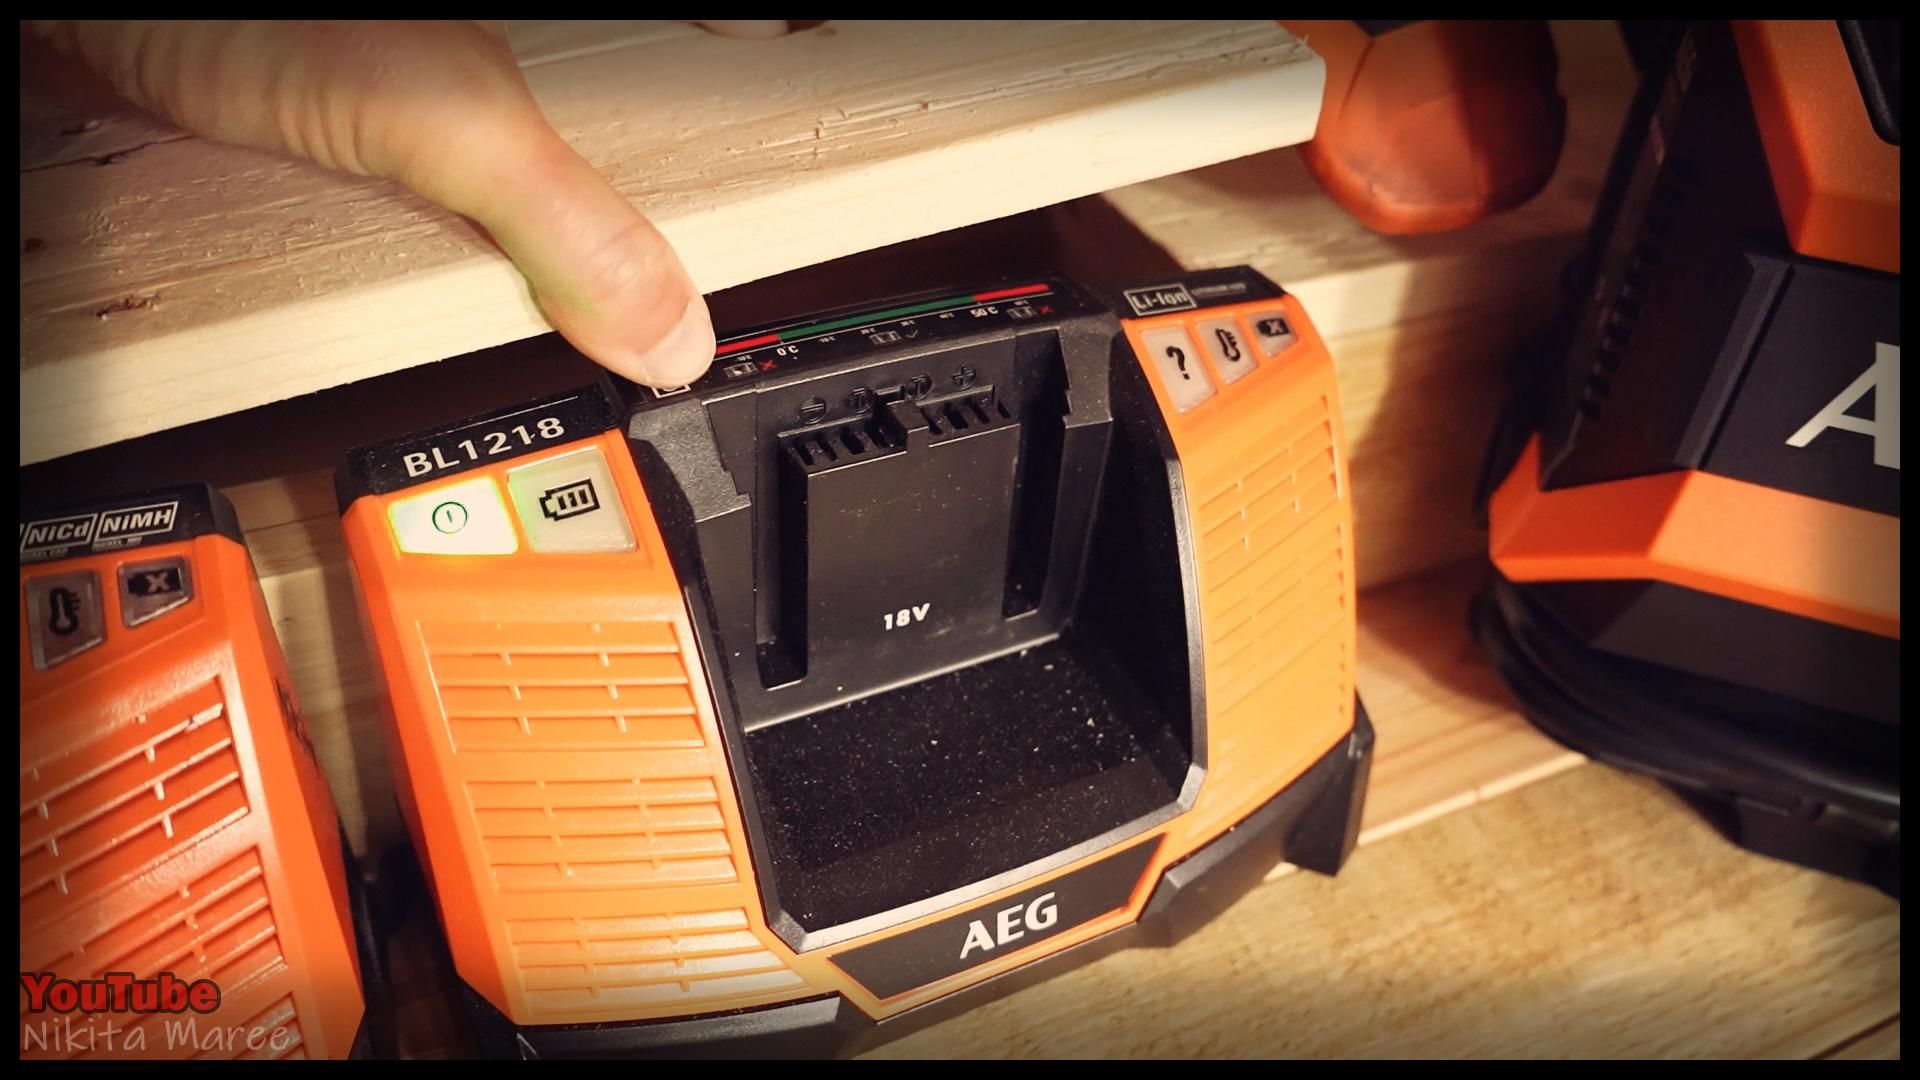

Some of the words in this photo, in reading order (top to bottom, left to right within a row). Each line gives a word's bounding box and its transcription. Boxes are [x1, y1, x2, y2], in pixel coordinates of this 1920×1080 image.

[403, 417, 566, 478] BL1218
[102, 509, 172, 533] NiMH
[883, 602, 931, 631] 18V
[959, 891, 1058, 960] AEG
